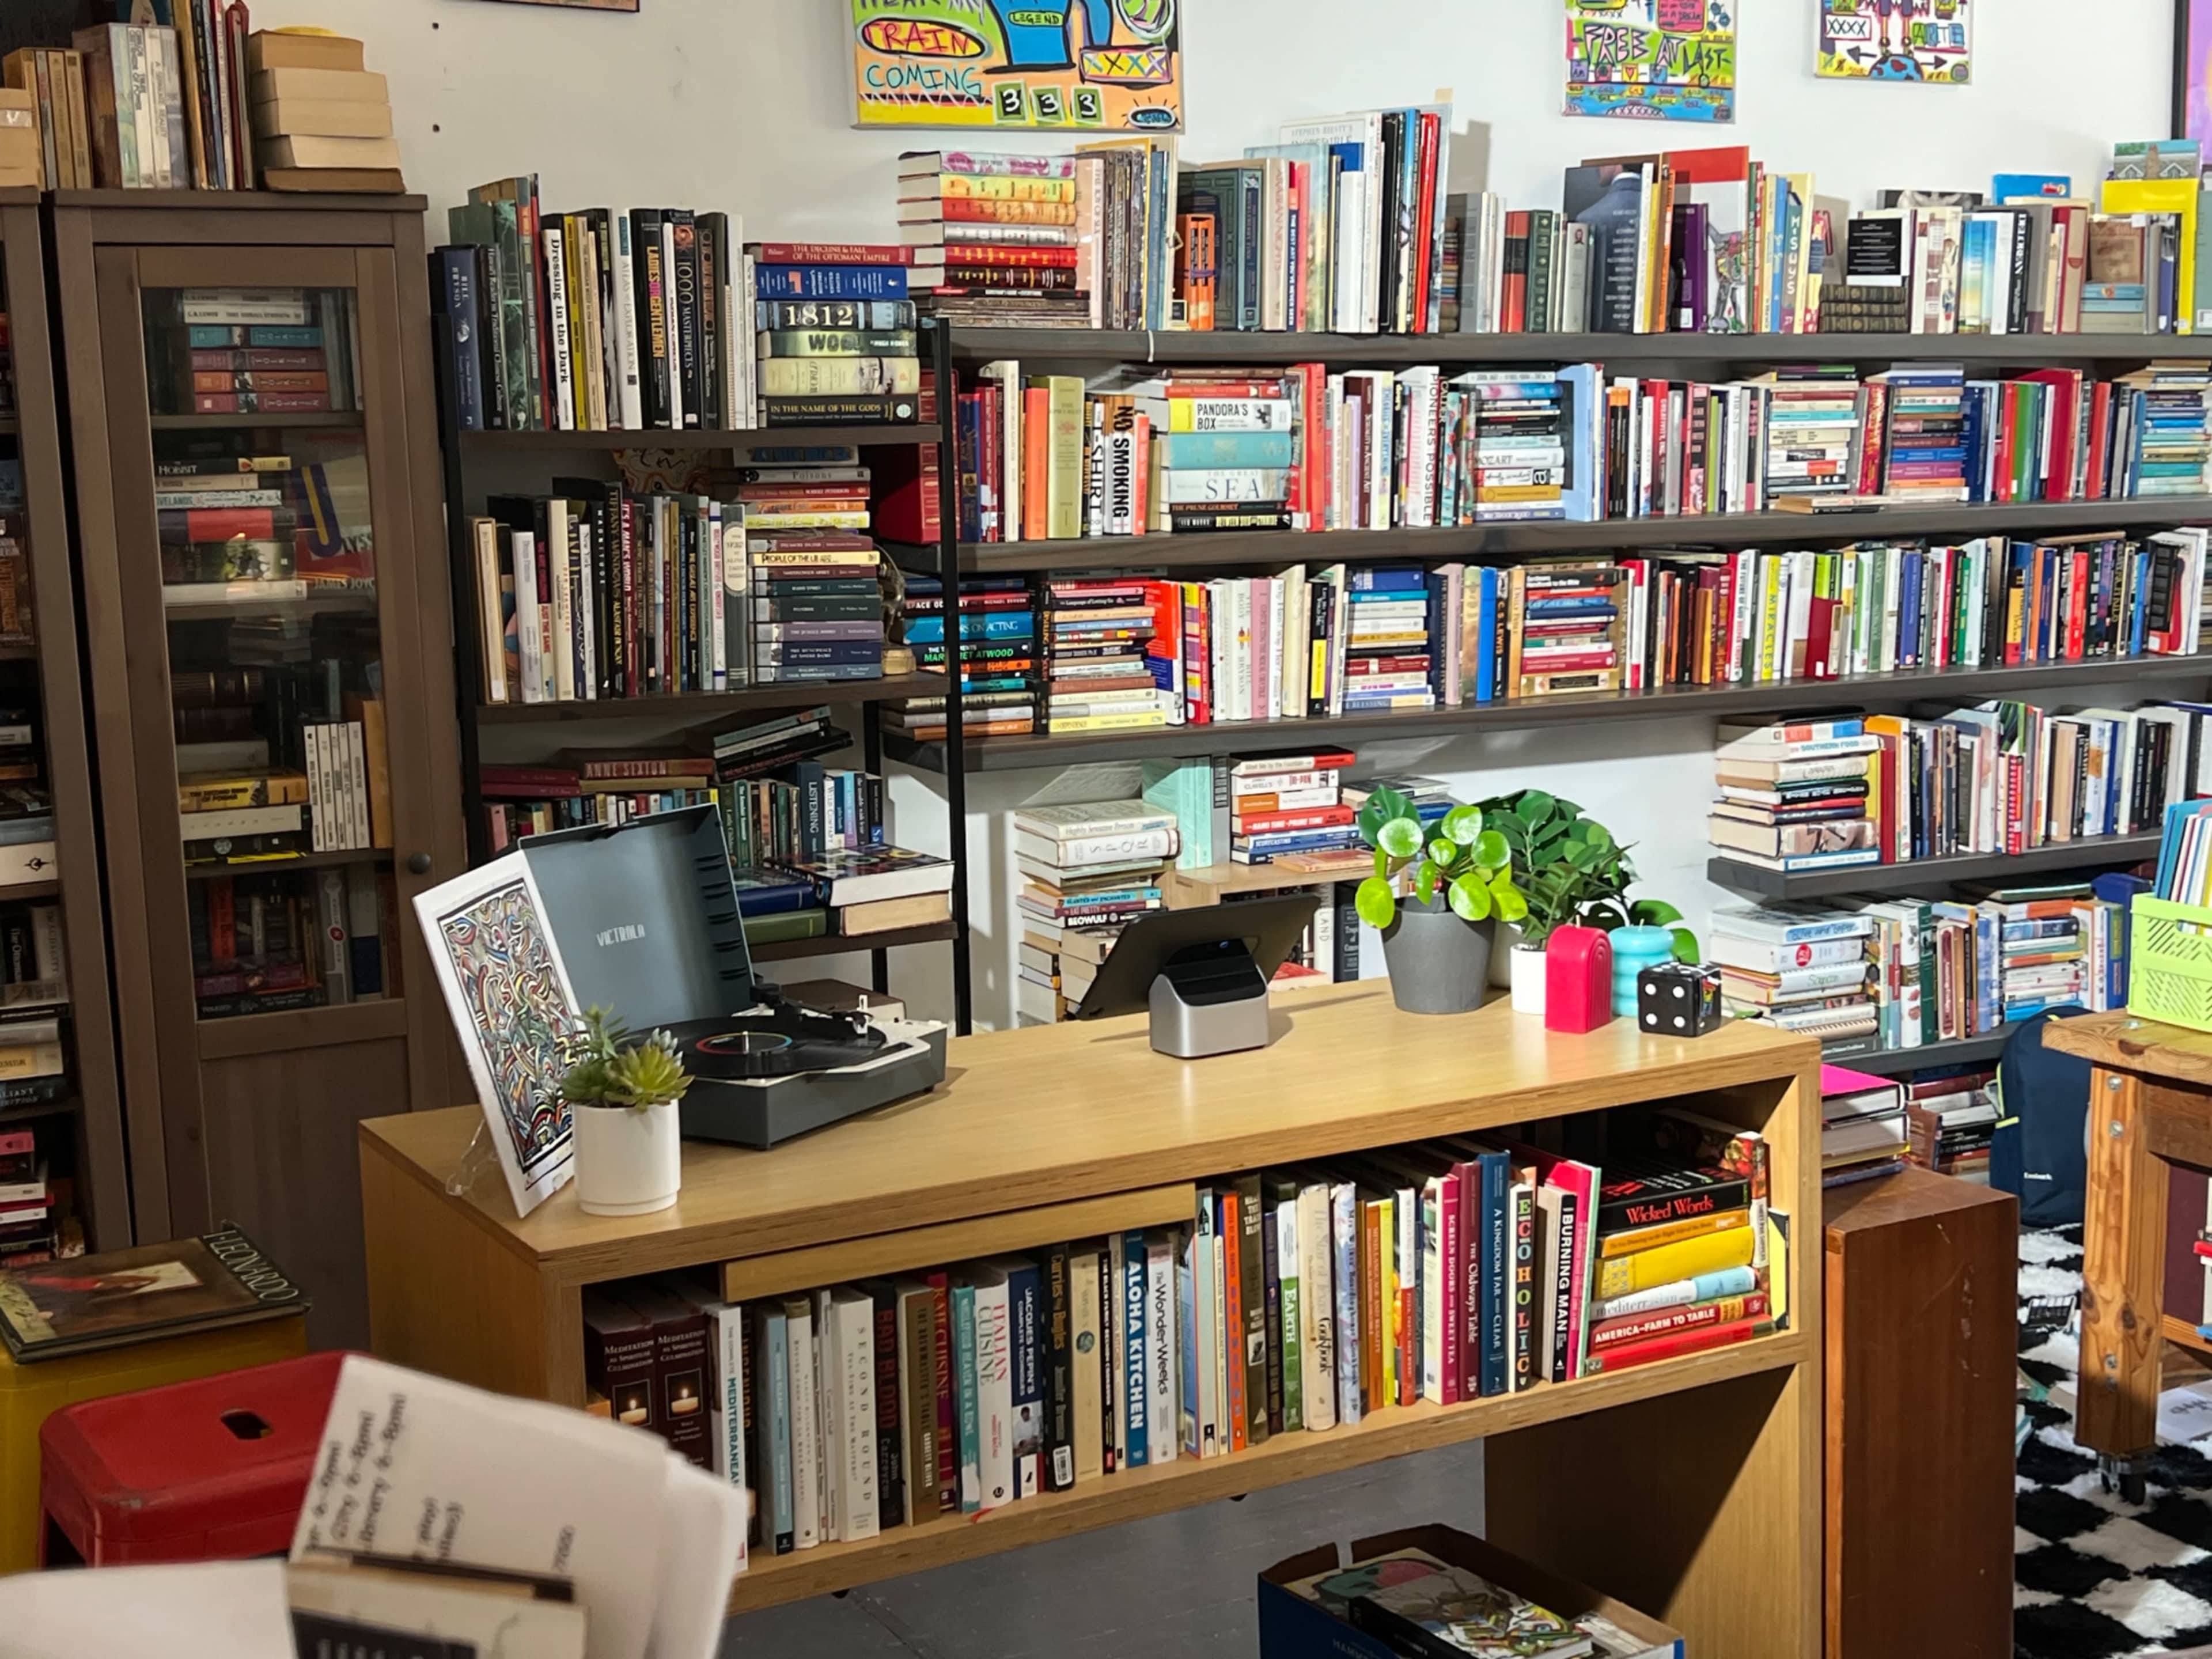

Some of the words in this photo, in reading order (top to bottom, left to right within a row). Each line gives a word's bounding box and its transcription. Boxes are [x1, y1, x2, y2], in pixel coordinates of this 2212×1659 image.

[1012, 13, 1060, 26] LEGEND
[1826, 19, 1867, 37] XXXX
[864, 24, 970, 56] TRAIN
[1584, 22, 1650, 67] FREE
[1656, 33, 1687, 70] AT
[1682, 40, 1728, 75] LAST
[866, 63, 983, 95] COMING
[1003, 89, 1021, 112] 3
[1041, 94, 1059, 113] 3
[1079, 94, 1096, 116] 3
[808, 245, 841, 253] DECLINE
[824, 253, 861, 262] OTTOMAN
[863, 253, 890, 262] EMPIRE
[550, 238, 563, 300] Dressing
[677, 261, 693, 304] 1000
[556, 305, 565, 321] in
[786, 302, 854, 327] 1812
[557, 324, 566, 346] the
[681, 306, 693, 368] MASTERPIECES
[559, 350, 569, 384] Dark
[771, 404, 780, 412] IN
[783, 404, 799, 412] THE
[801, 404, 825, 412] NAME
[828, 404, 838, 412] OF
[841, 404, 856, 412] THE
[858, 404, 881, 412] GODS
[1197, 404, 1248, 416] PANDORA'S
[1427, 373, 1438, 446] PIONEERS
[1439, 381, 1449, 423] CALDER
[1113, 406, 1134, 431] NO
[1197, 418, 1217, 430] BOX
[1089, 422, 1103, 512] T-SHIRT
[1112, 438, 1130, 517] SMOKING
[1205, 479, 1260, 500] SEA
[1423, 453, 1437, 521] POSSIBLE
[609, 490, 620, 536] TIFFANY
[597, 510, 605, 585] MAGNITUDE
[622, 531, 631, 560] MAN'S
[611, 539, 622, 599] WINDOWS
[623, 561, 632, 592] WORLD
[906, 599, 930, 609] SPACE
[986, 621, 1018, 632] ACTING
[1496, 623, 1504, 654] LEWIS
[1764, 594, 1777, 669] MIRACLES
[975, 649, 1014, 658] ATWOOD
[585, 761, 621, 779] ANNE
[624, 760, 666, 777] SEXTON
[808, 782, 819, 833] LISTENING
[595, 923, 645, 948] VICTROLA
[1067, 914, 1107, 926] BEOWULF
[1494, 1209, 1502, 1217] A
[1626, 1201, 1671, 1224] Wicked
[1674, 1194, 1714, 1216] Words
[1448, 1214, 1456, 1254] SCREEN
[1494, 1219, 1502, 1273] KINGDOM
[1559, 1214, 1574, 1290] BURNING
[1155, 1271, 1165, 1285] The
[1448, 1256, 1456, 1292] DOORS
[1465, 1263, 1478, 1312] Oldways
[1494, 1276, 1502, 1296] FAR
[1128, 1261, 1143, 1334] ALOHA
[1556, 1293, 1570, 1331] MAN
[876, 1309, 895, 1352] BAD
[1024, 1288, 1034, 1345] JACQUES
[1283, 1287, 1299, 1344] EARTH
[1448, 1309, 1456, 1342] SWEET
[1468, 1315, 1478, 1343] Table
[1672, 1315, 1685, 1325] TO
[1687, 1308, 1715, 1322] TABLE
[604, 1339, 655, 1354] MEDITATION
[657, 1330, 706, 1344] MEDITATION
[977, 1306, 995, 1387] CUISINE
[993, 1303, 1007, 1382] ITALIAN
[1315, 1317, 1332, 1378] Cookbook
[1494, 1315, 1502, 1349] CLEAR
[857, 1327, 869, 1412] SECOND
[1129, 1338, 1143, 1429] KITCHEN
[877, 1359, 897, 1429] BLOOD
[861, 1430, 872, 1501] ROUND
[891, 1453, 899, 1480] John
[924, 1463, 933, 1487] OLIVER
